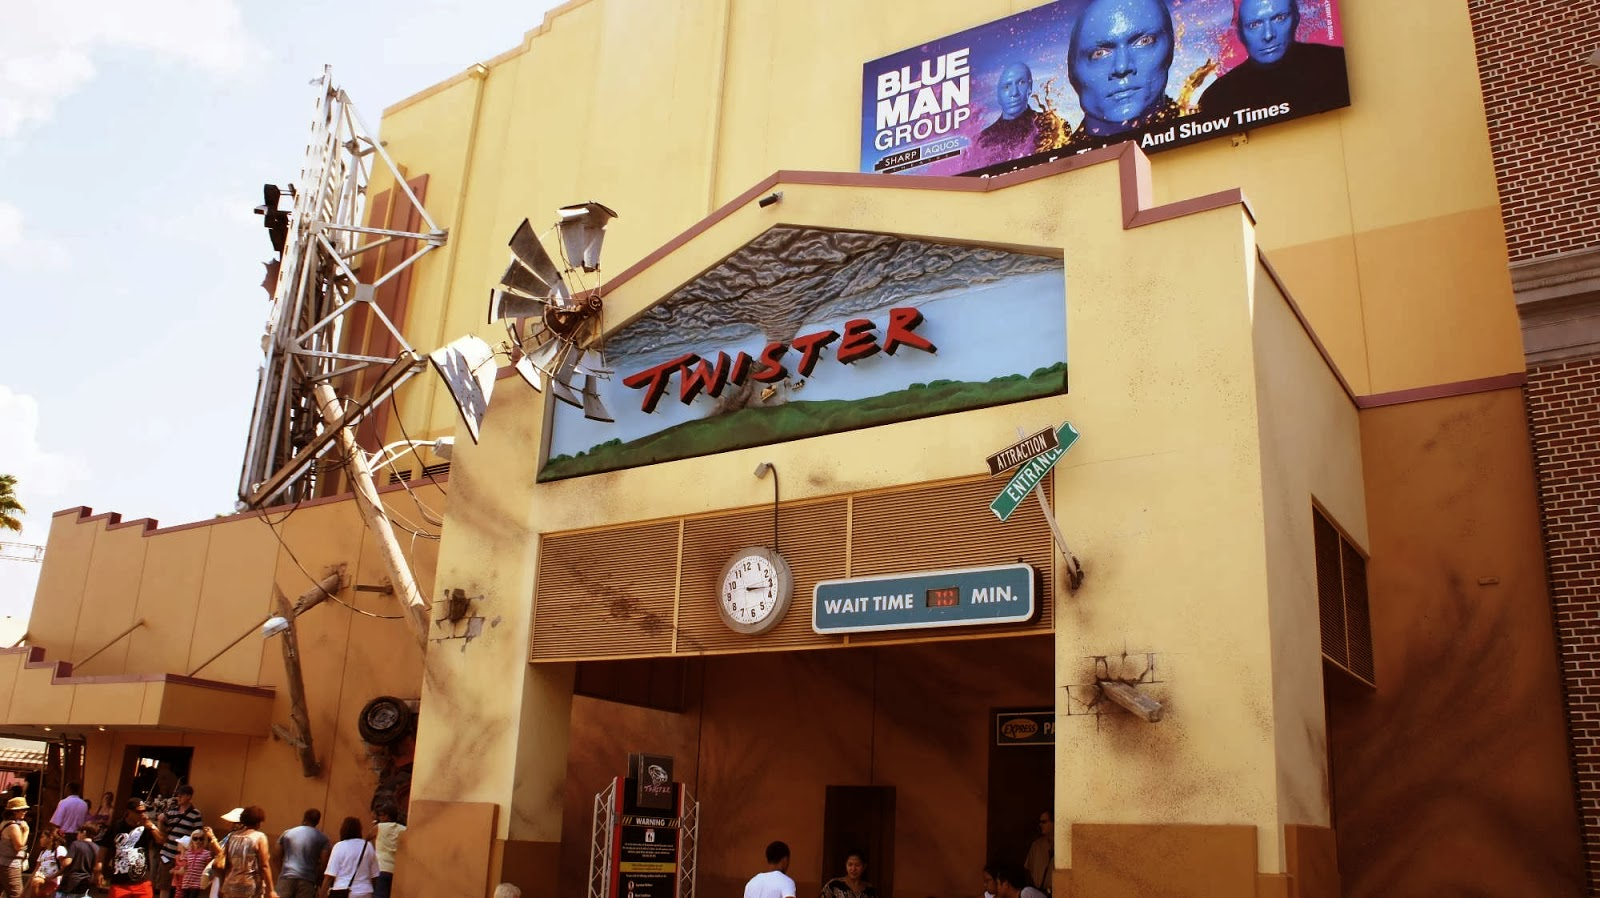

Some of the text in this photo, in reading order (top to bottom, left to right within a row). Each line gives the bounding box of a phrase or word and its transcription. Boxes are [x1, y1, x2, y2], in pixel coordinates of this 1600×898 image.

[877, 47, 970, 101] BLUE
[876, 74, 970, 131] MAN
[874, 107, 971, 151] GROUP
[1140, 102, 1291, 148] And Show Times
[884, 151, 917, 167] SHARP
[924, 139, 960, 155] AQUOS
[622, 307, 937, 414] TWISTER
[996, 433, 1048, 471] ATTRACTION
[743, 562, 751, 572] 12
[757, 562, 761, 571] 1
[735, 570, 742, 579] 11
[764, 569, 769, 578] 2
[728, 581, 737, 590] 10
[768, 578, 773, 588] 3
[727, 593, 732, 601] 9
[768, 590, 772, 598] 4
[824, 597, 869, 615] WAIT
[872, 593, 914, 611] TIME
[971, 586, 1018, 605] MIN.
[760, 602, 765, 610] 5
[740, 608, 745, 617] 7
[751, 609, 756, 617] 6
[1004, 723, 1037, 738] EXPRESS
[636, 818, 666, 827] WARNING
